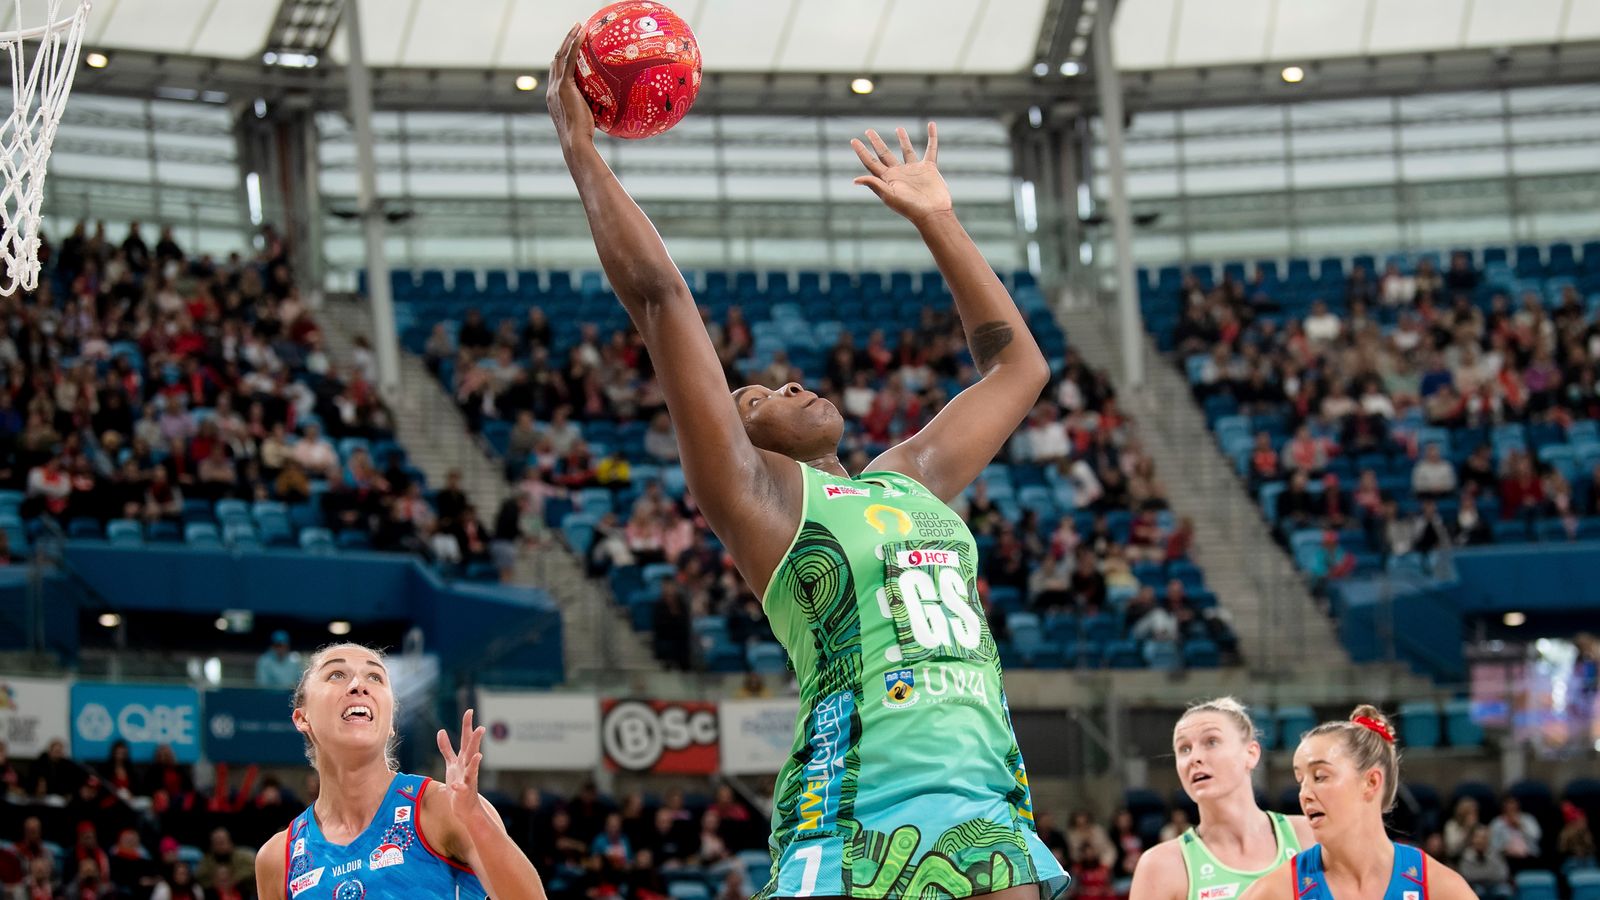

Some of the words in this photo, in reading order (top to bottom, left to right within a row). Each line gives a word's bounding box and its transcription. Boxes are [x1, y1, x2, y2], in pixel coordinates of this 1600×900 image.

[911, 512, 939, 520] GOLD
[915, 520, 964, 529] INDUSTRY
[919, 529, 955, 537] GROUP
[924, 552, 948, 564] HCF
[898, 568, 981, 649] GS
[118, 703, 193, 744] QBE
[332, 859, 362, 877] VALOUR
